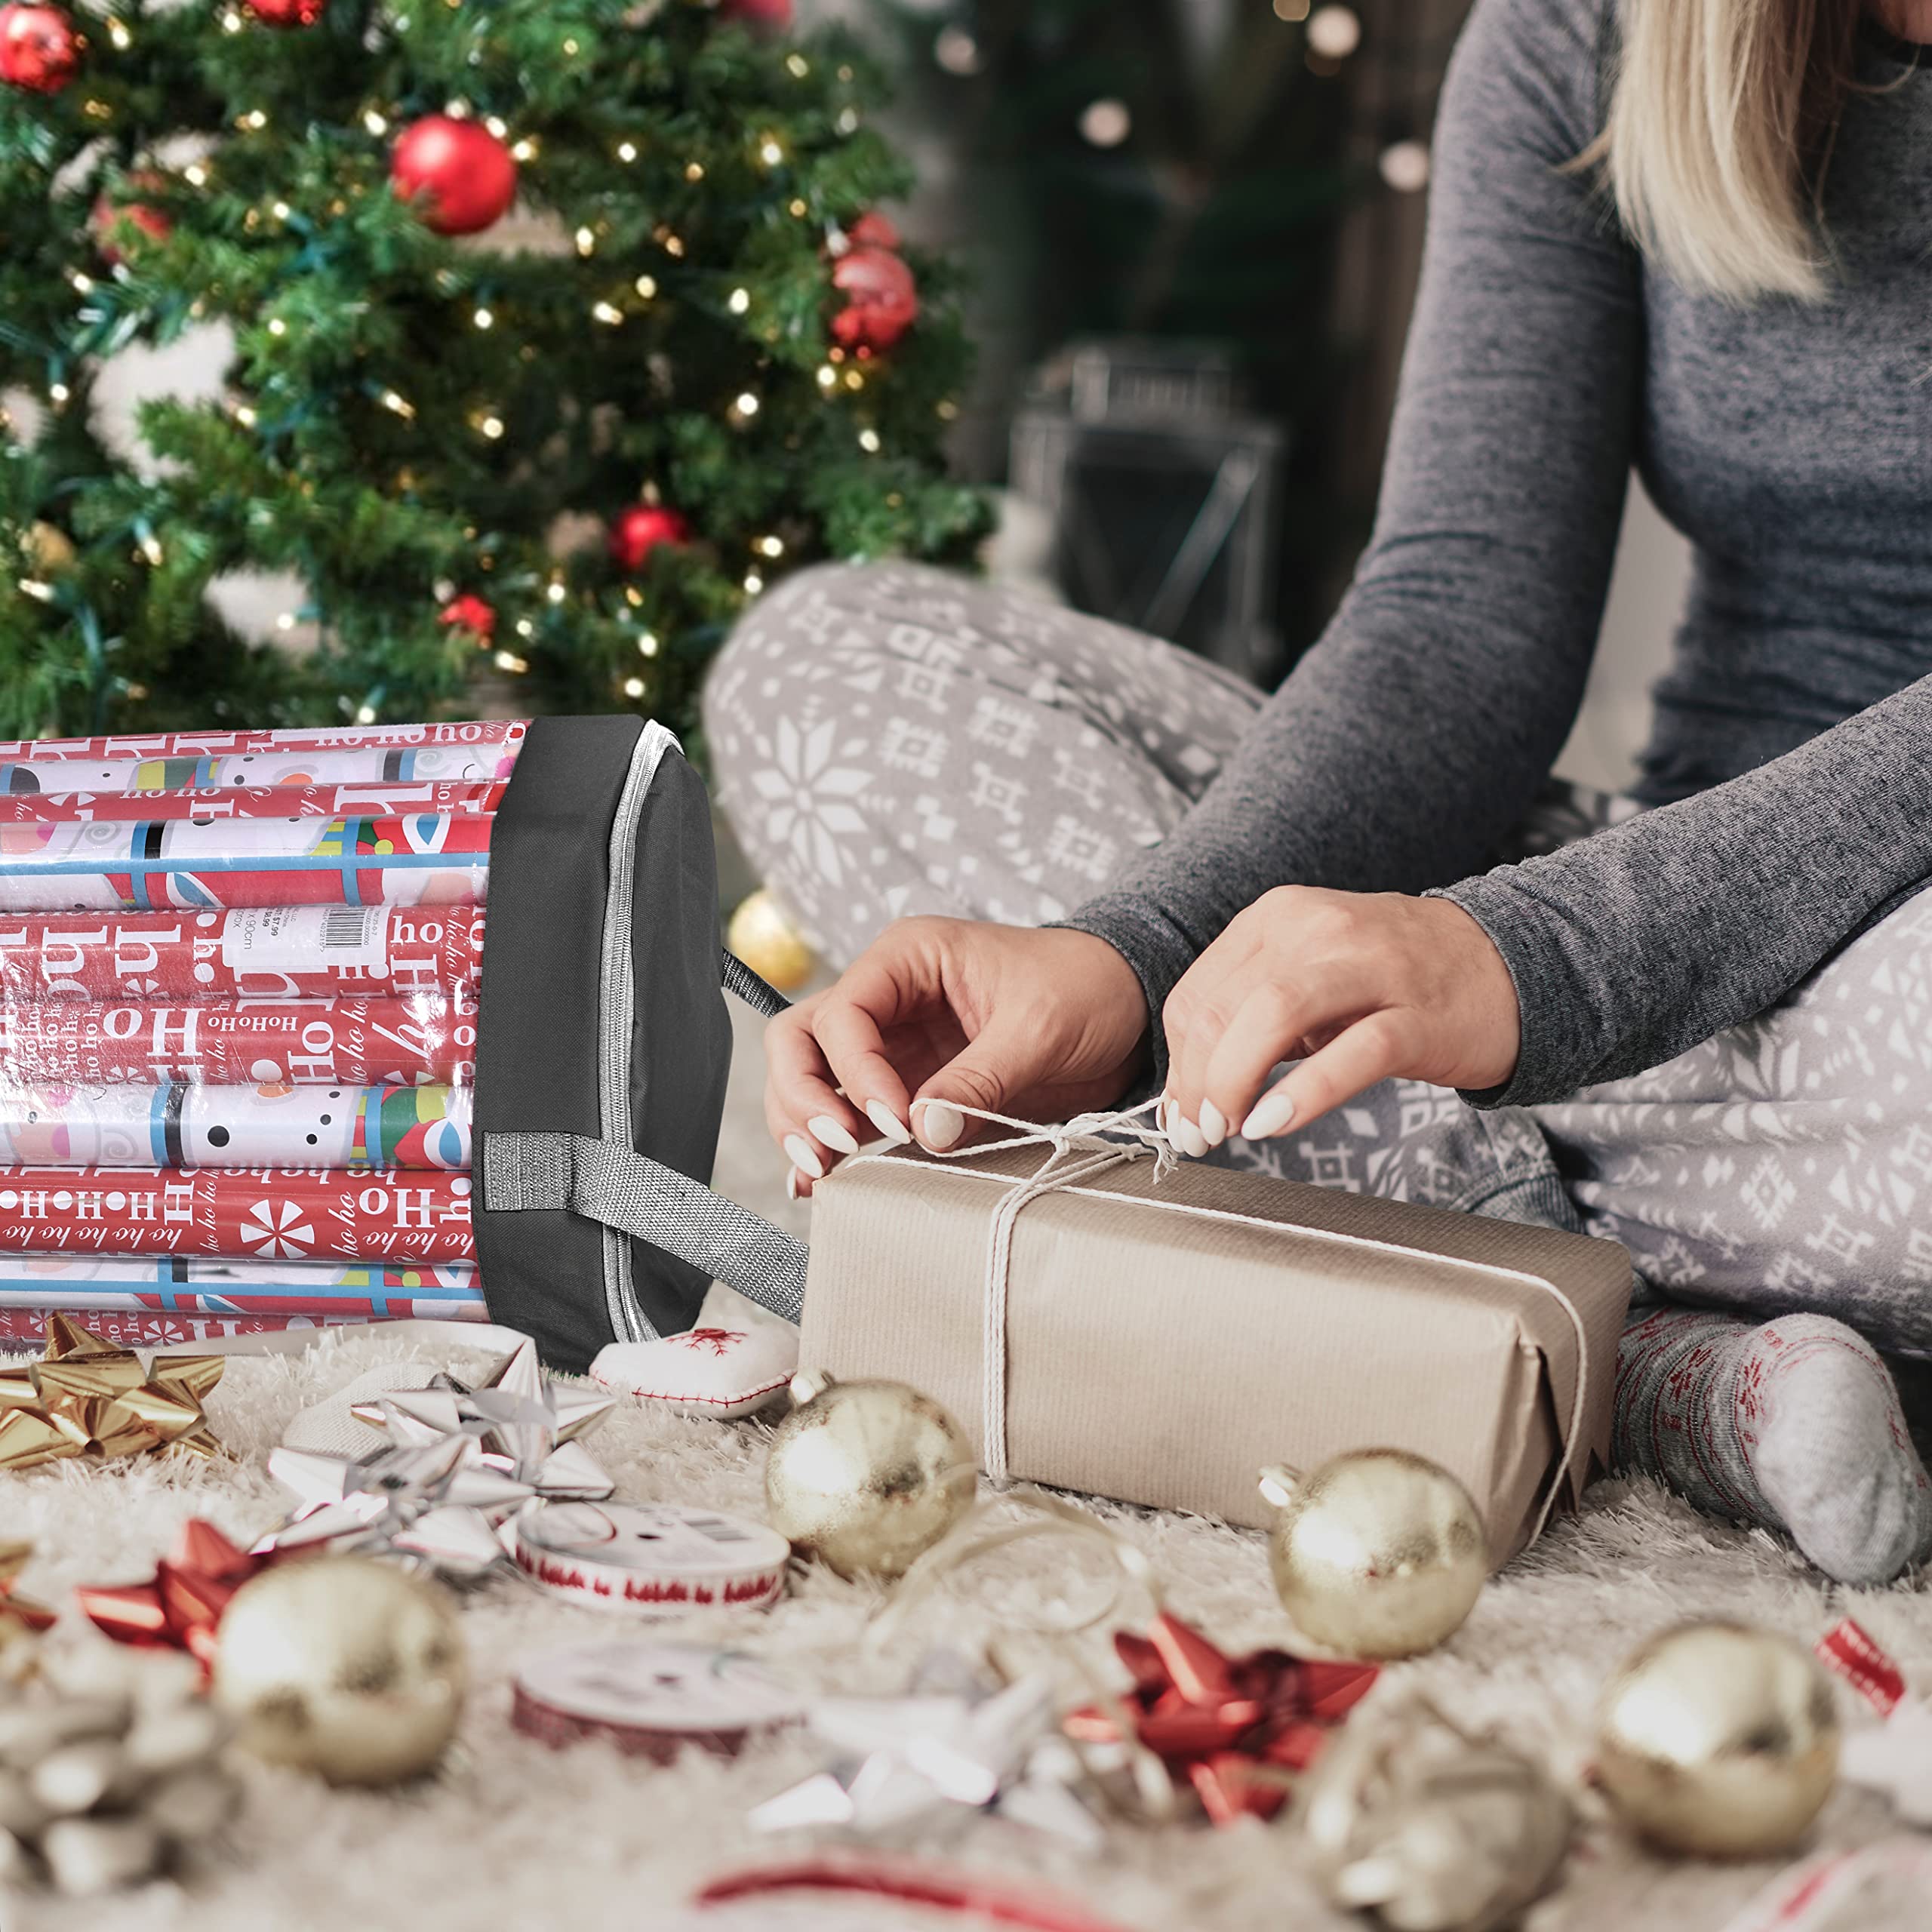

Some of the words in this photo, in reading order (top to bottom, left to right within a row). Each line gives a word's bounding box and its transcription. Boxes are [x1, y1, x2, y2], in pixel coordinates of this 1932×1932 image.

[263, 912, 272, 928] $8.99
[271, 917, 281, 936] $7.99
[390, 915, 444, 943] ho
[244, 920, 257, 949] 90cm
[103, 1008, 206, 1057] Ho
[208, 1017, 297, 1032] HoHoHo
[288, 1021, 340, 1084] Ho
[358, 1188, 435, 1228] Ho
[2, 1226, 35, 1247] ho
[38, 1226, 72, 1247] ho
[75, 1226, 108, 1248] ho
[112, 1228, 145, 1249] ho
[149, 1228, 183, 1249] ho
[362, 1232, 398, 1254] ho
[401, 1232, 438, 1254] ho
